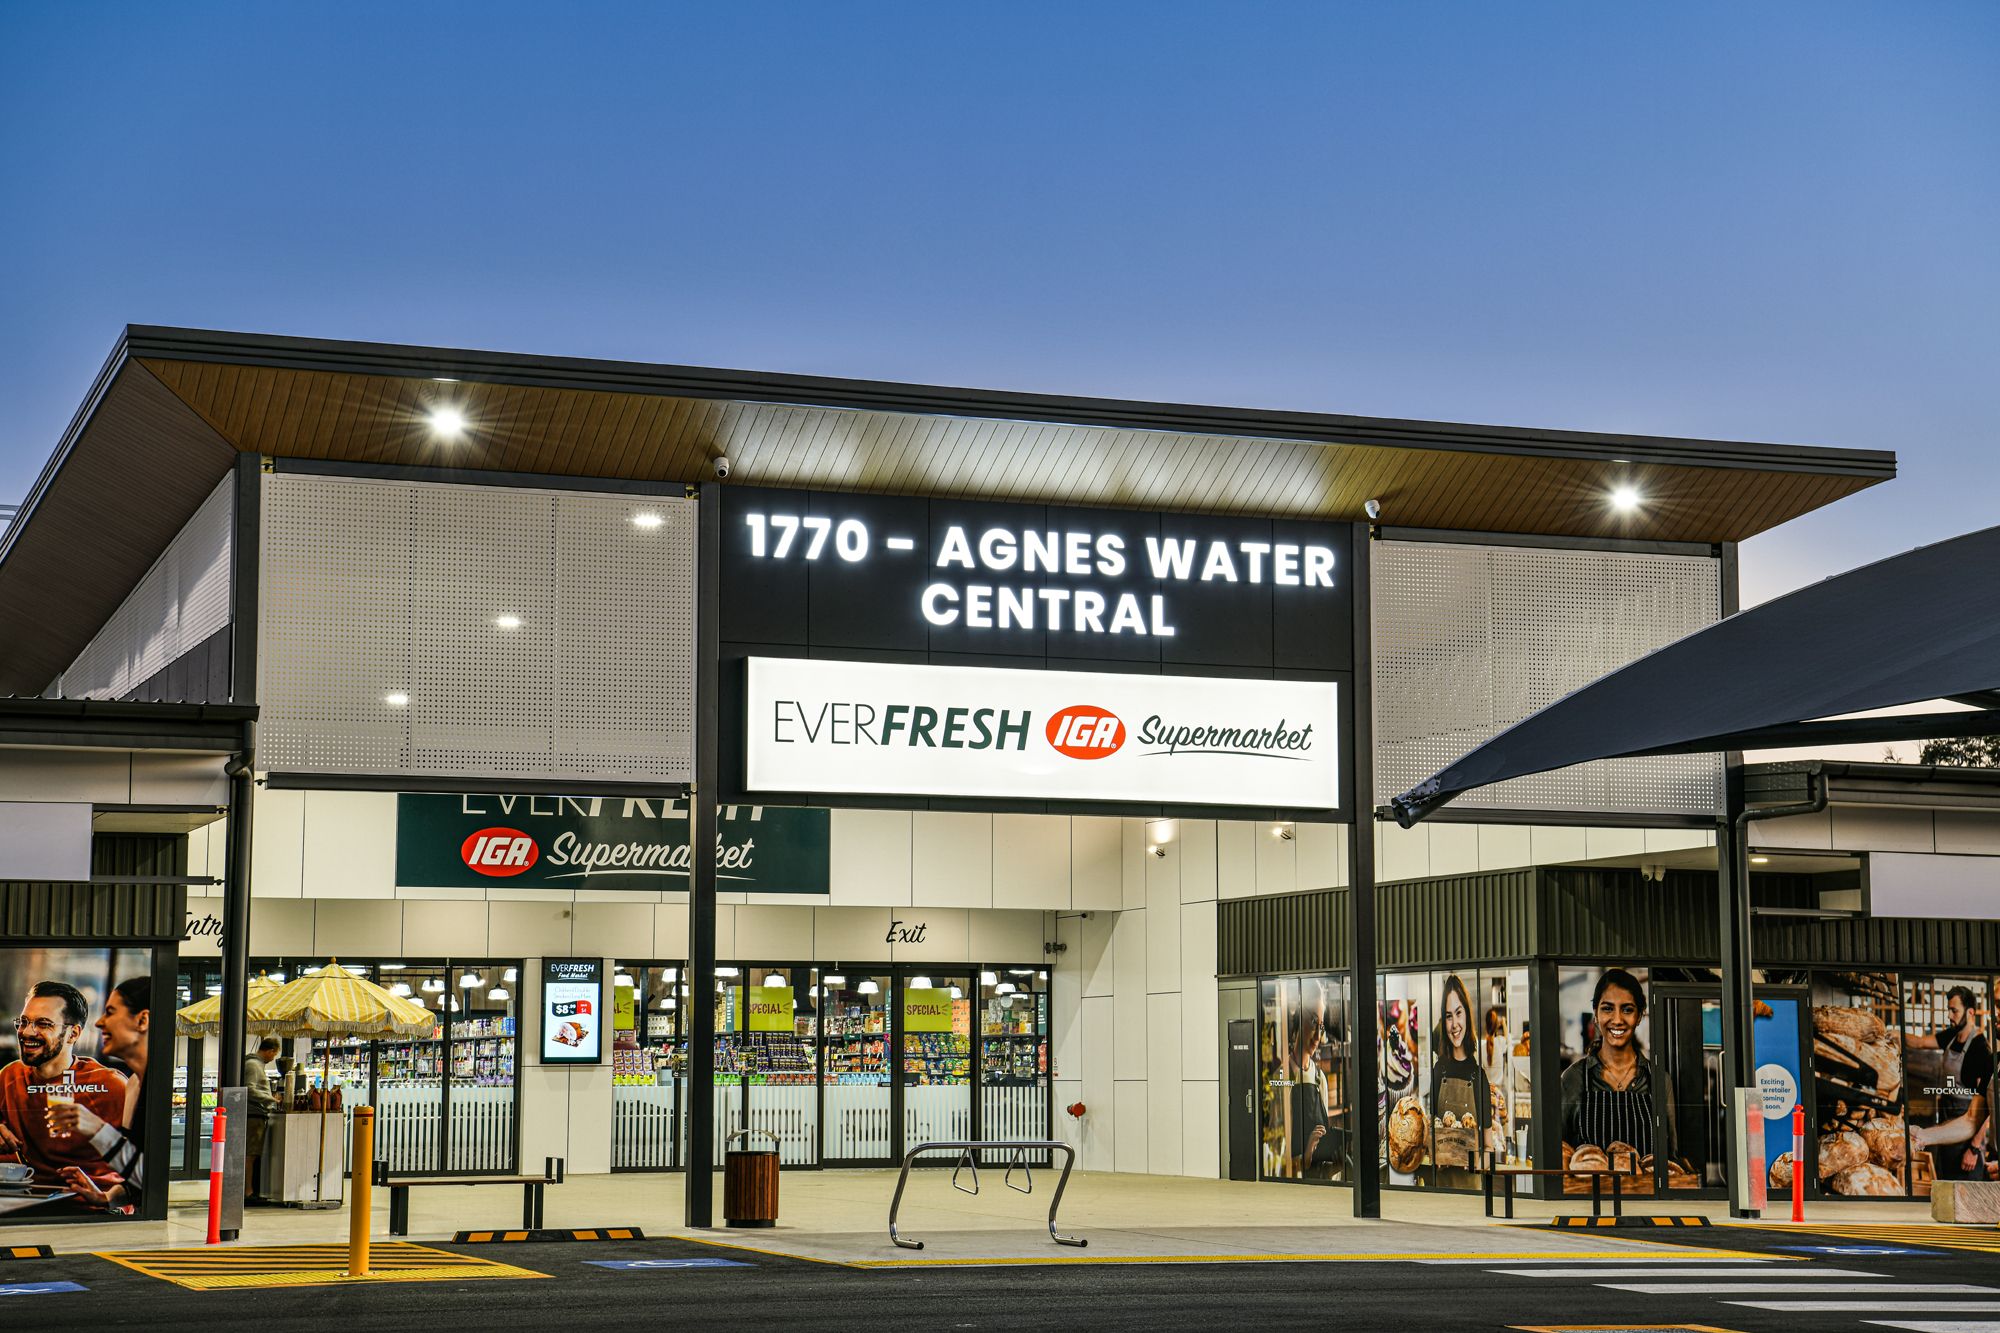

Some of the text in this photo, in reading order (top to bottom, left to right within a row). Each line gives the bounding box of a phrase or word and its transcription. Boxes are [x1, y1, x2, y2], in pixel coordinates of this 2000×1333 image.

[746, 513, 869, 562] 1770
[936, 526, 1126, 576] AGNES
[1145, 537, 1336, 587] WATER
[921, 583, 1175, 636] CENTRAL
[775, 700, 1031, 751] EVERFRESH
[1053, 715, 1119, 748] IGA
[1137, 714, 1313, 756] Supermarket
[468, 836, 533, 866] IGA
[546, 831, 755, 877] Supermaket
[185, 911, 223, 948] ntry
[886, 921, 927, 943] Exit
[551, 963, 595, 972] EVERFRESH
[906, 1004, 941, 1016] SPECIAL
[27, 1084, 109, 1094] STOCKWELL
[1760, 1078, 1785, 1086] Exciting
[1923, 1087, 1980, 1095] STOCKWELL
